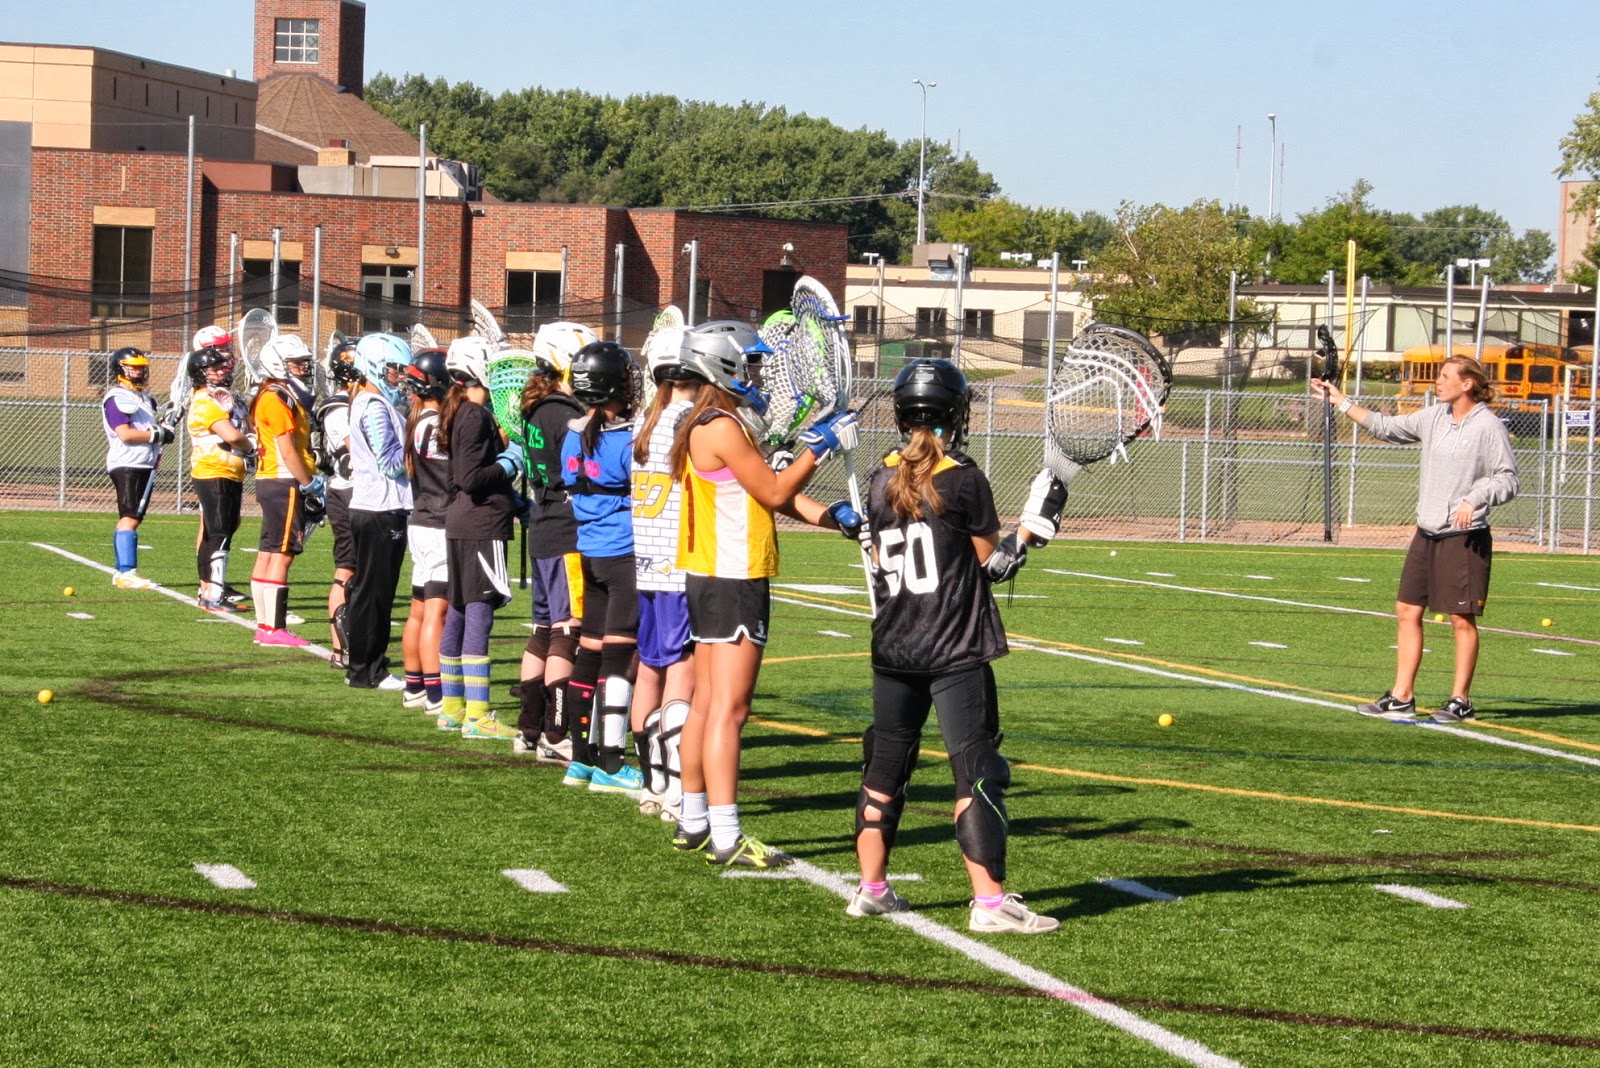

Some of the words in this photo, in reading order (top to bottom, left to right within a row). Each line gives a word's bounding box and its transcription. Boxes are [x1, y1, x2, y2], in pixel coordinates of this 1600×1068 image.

[407, 270, 414, 278] 26
[879, 522, 939, 596] 50
[554, 687, 563, 726] BRINE
